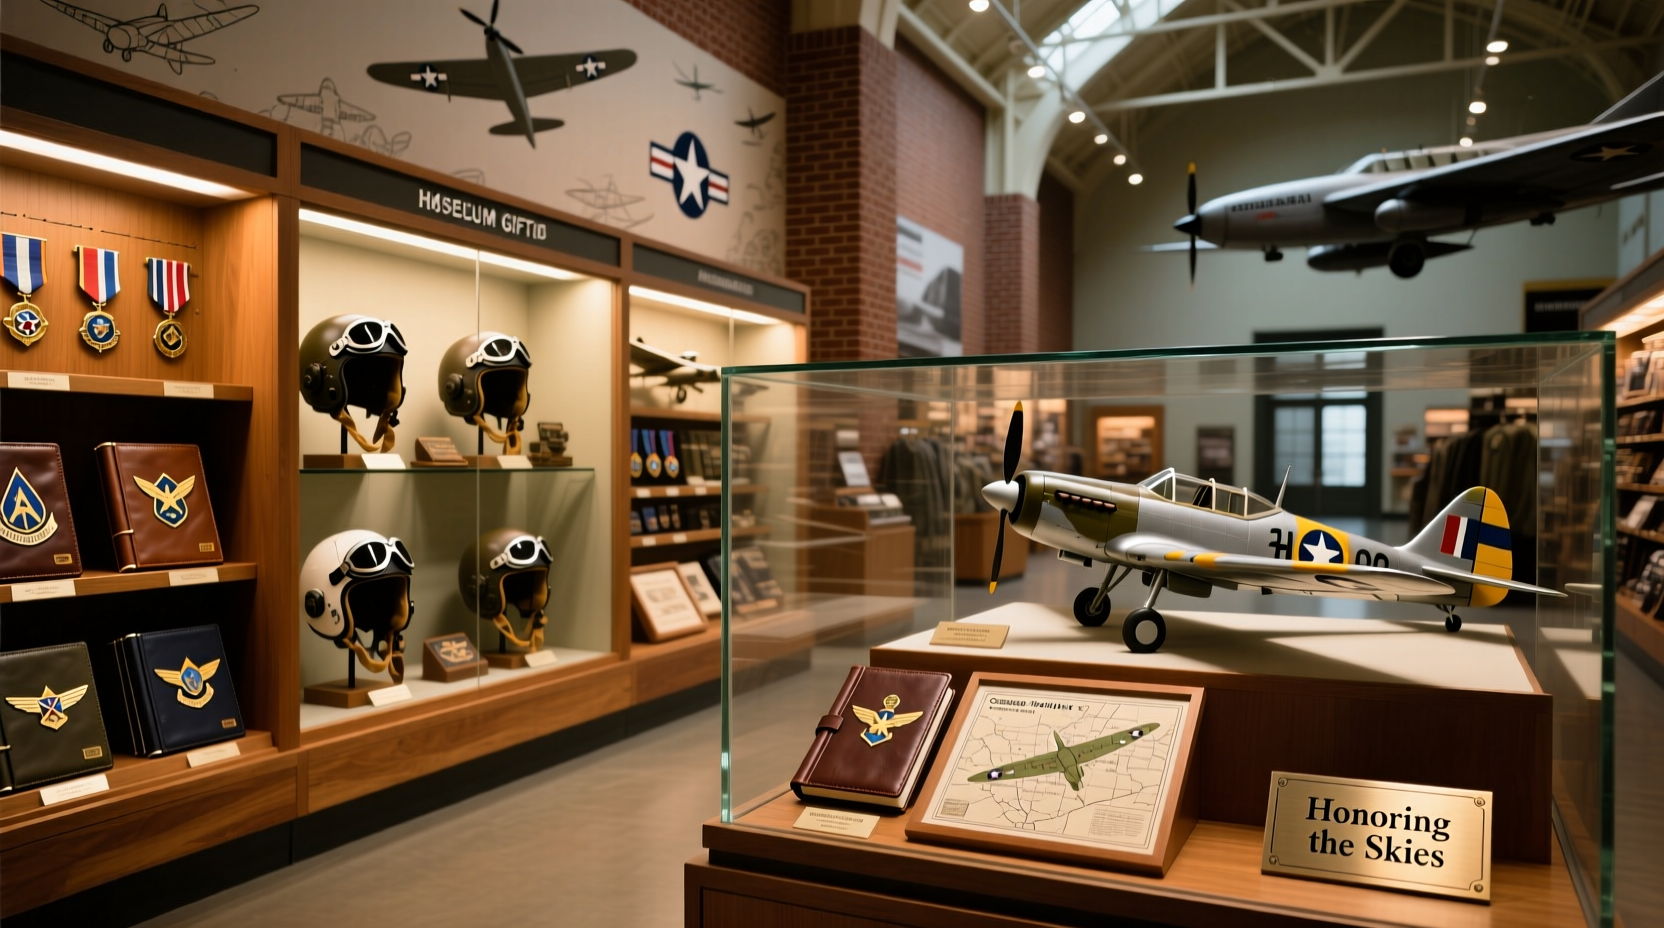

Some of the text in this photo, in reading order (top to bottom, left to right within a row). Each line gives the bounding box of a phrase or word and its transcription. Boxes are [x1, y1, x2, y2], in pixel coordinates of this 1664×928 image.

[1305, 796, 1451, 842] Honoring
[1309, 829, 1444, 868] the Skies
